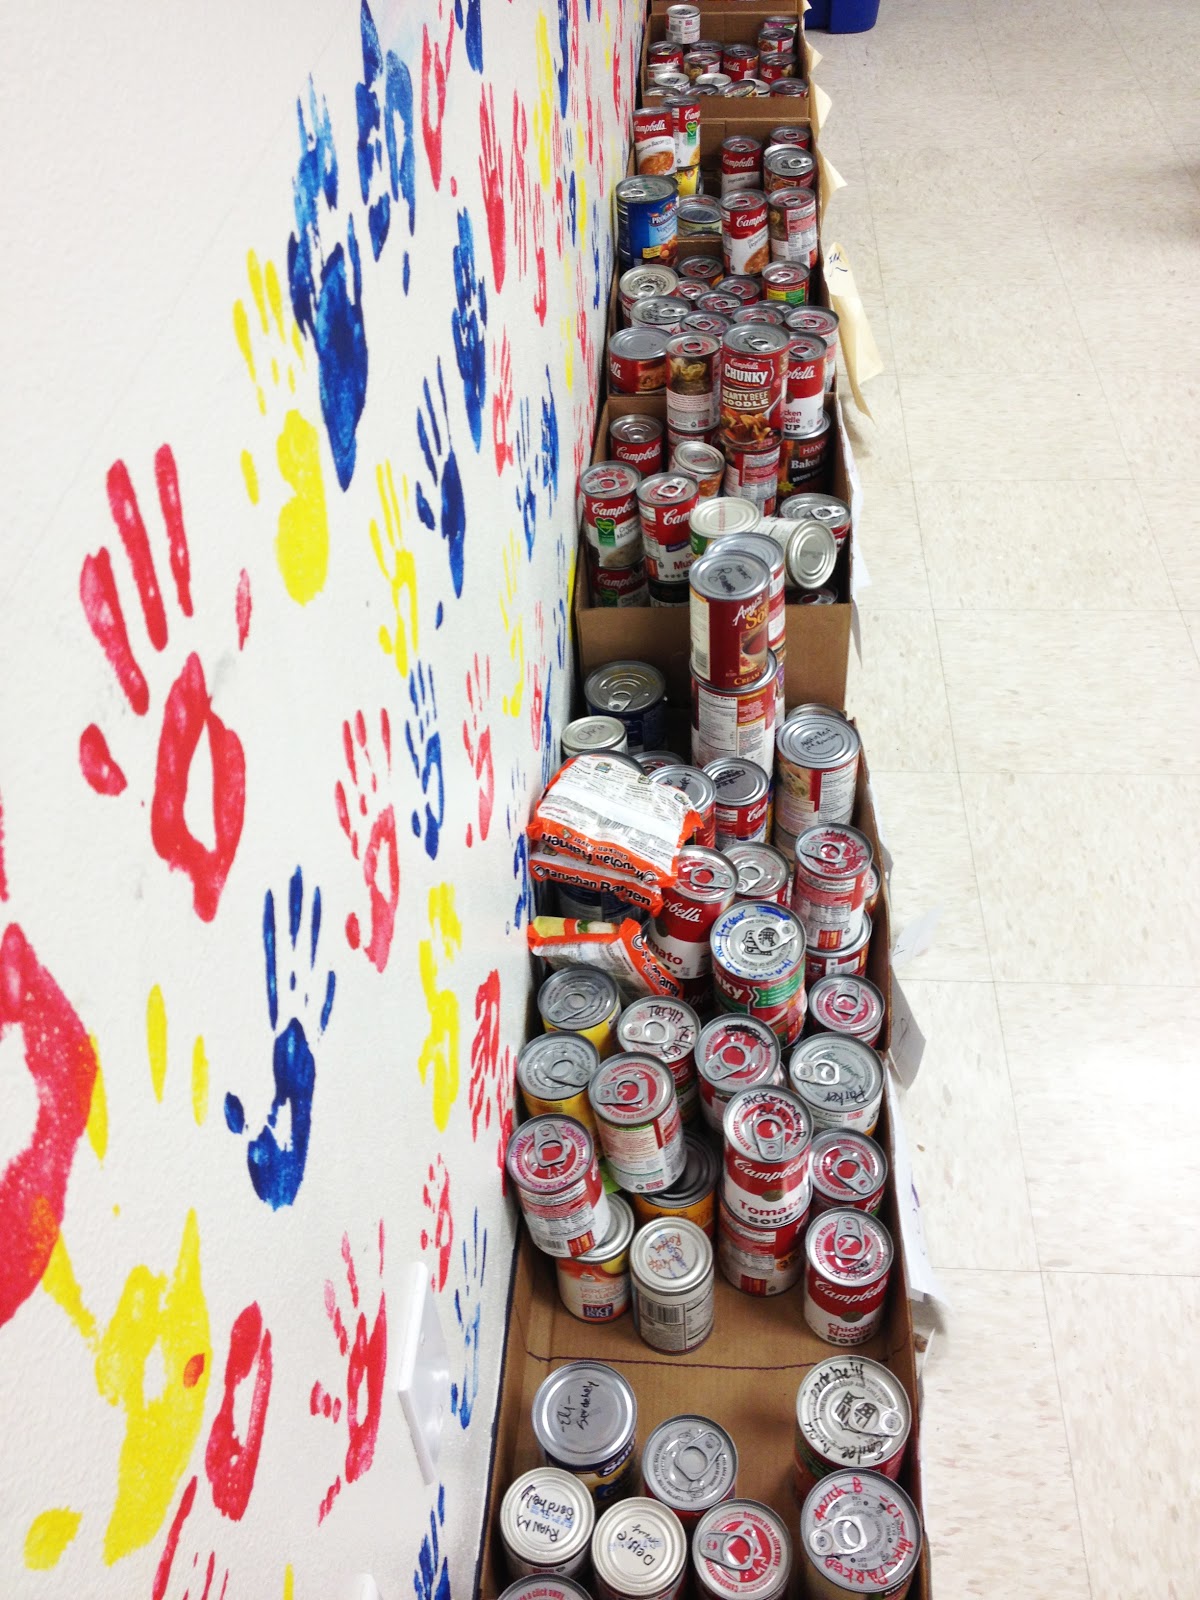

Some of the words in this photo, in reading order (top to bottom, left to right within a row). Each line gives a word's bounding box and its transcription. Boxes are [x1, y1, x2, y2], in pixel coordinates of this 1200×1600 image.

[724, 363, 769, 385] CHUNKY
[722, 396, 769, 407] NOODLE
[749, 390, 768, 401] BEEF
[784, 423, 802, 431] UP
[738, 1195, 803, 1218] Tomato
[827, 1321, 875, 1334] Chicken
